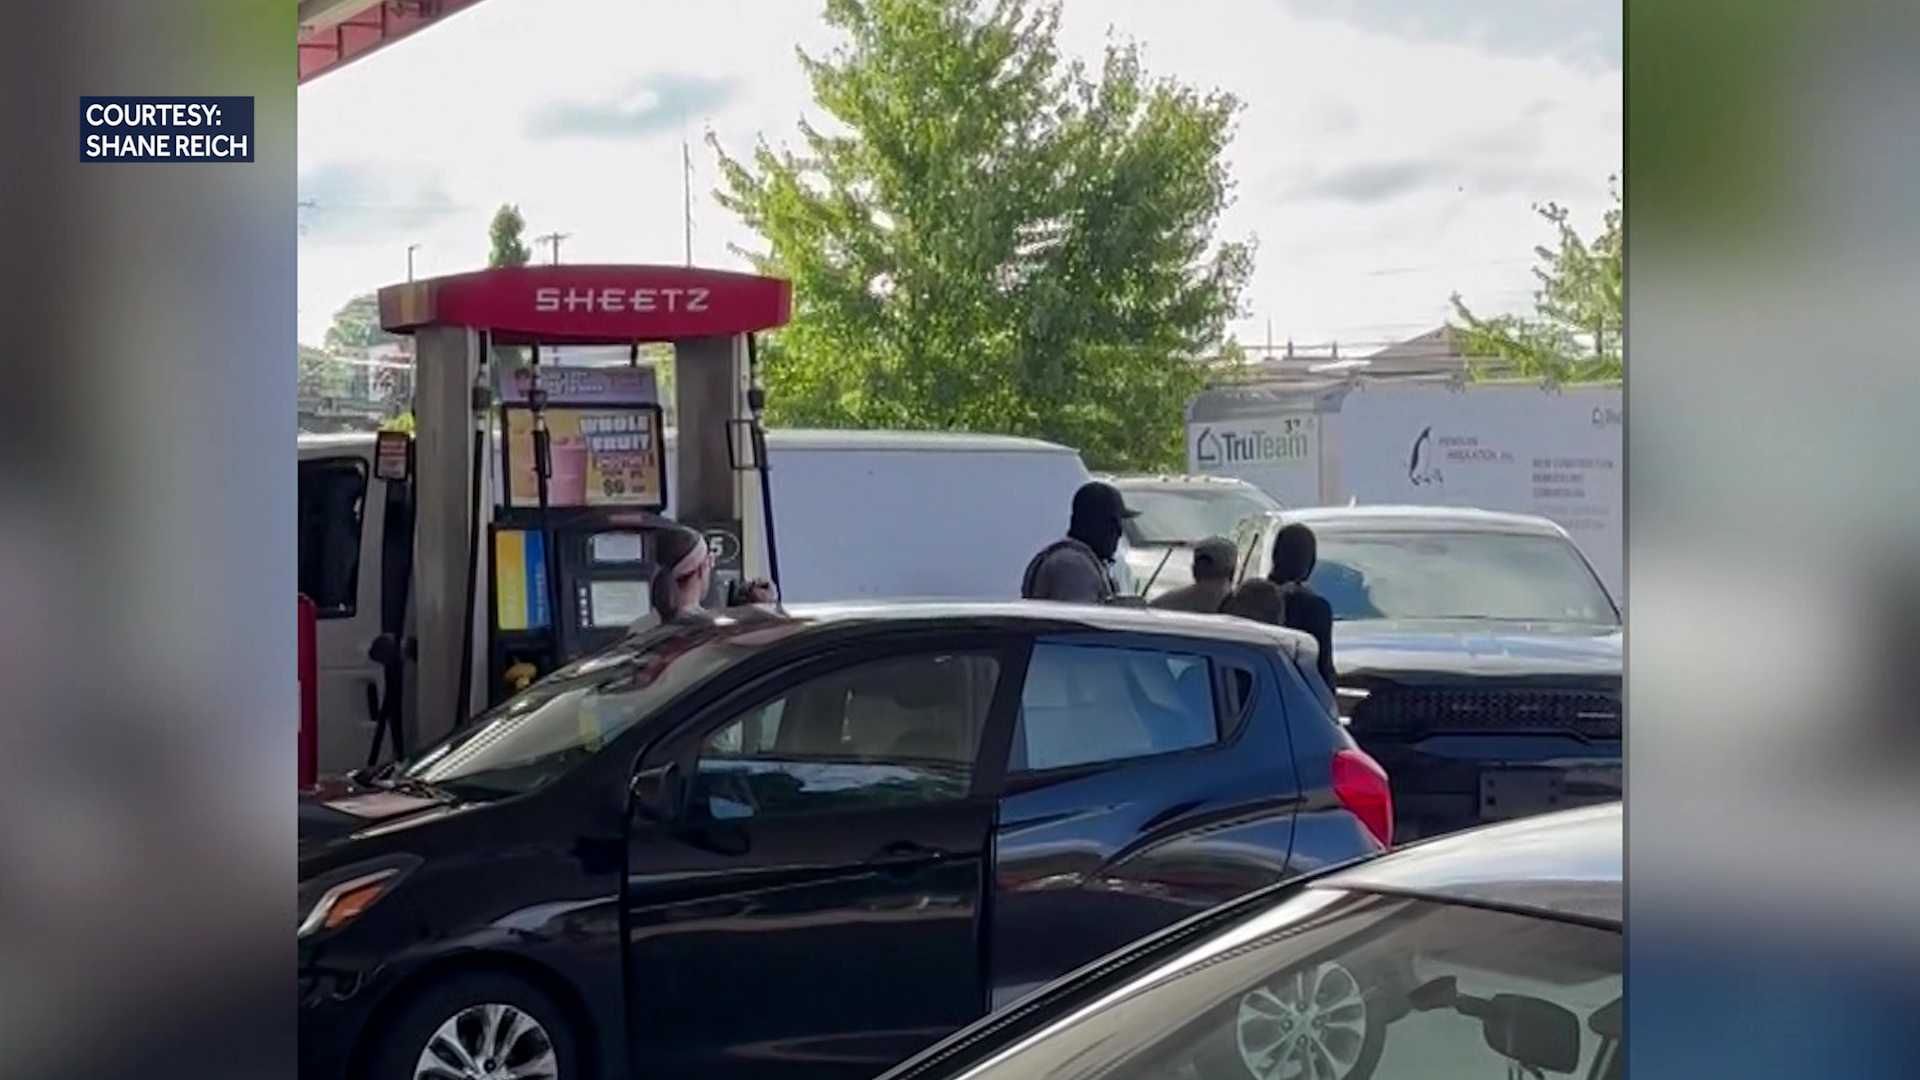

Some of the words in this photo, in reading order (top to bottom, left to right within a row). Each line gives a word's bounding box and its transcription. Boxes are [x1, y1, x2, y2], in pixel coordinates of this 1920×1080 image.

[535, 287, 711, 313] SHEETZ
[1221, 430, 1309, 461] TruTeam
[710, 537, 724, 556] 5
